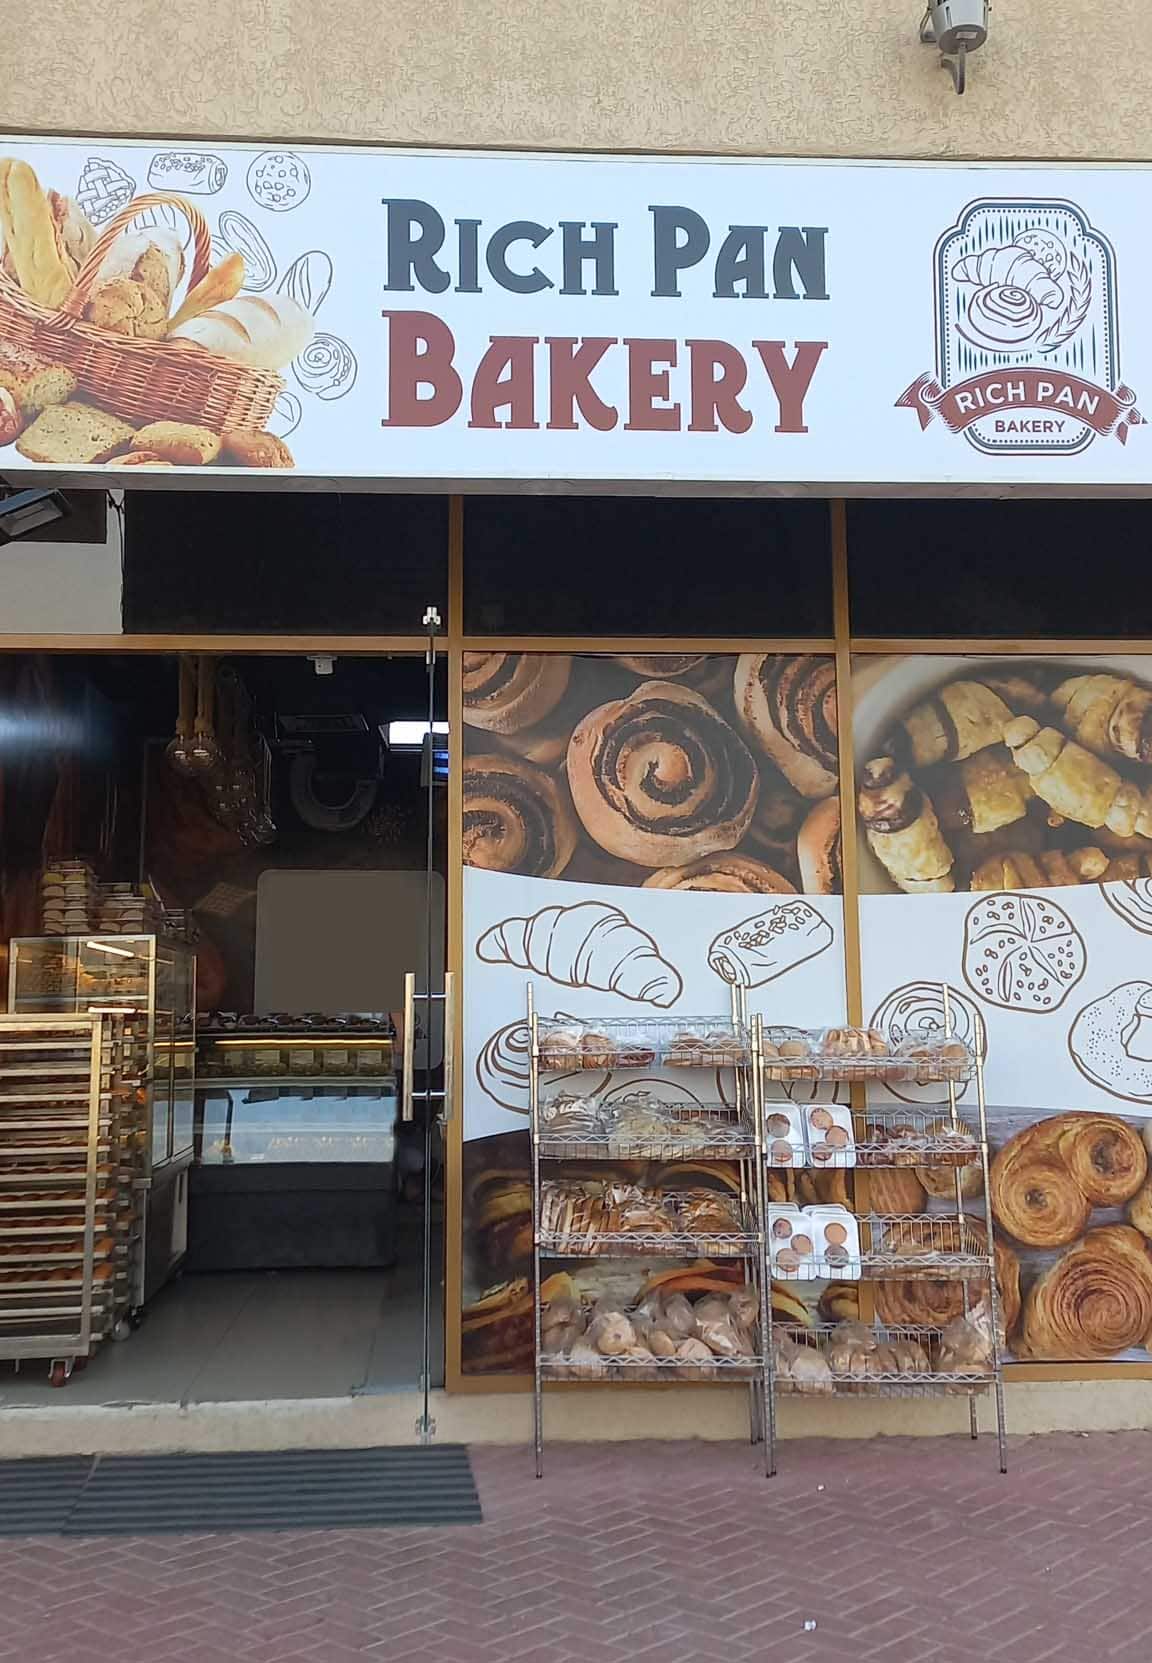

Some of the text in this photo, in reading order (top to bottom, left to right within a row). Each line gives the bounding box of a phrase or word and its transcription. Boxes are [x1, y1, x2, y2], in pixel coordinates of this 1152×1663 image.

[381, 198, 830, 299] RICH PAN
[382, 311, 828, 433] BAKERY
[955, 381, 1099, 414] RICH PAN
[995, 420, 1065, 432] BAKERY
